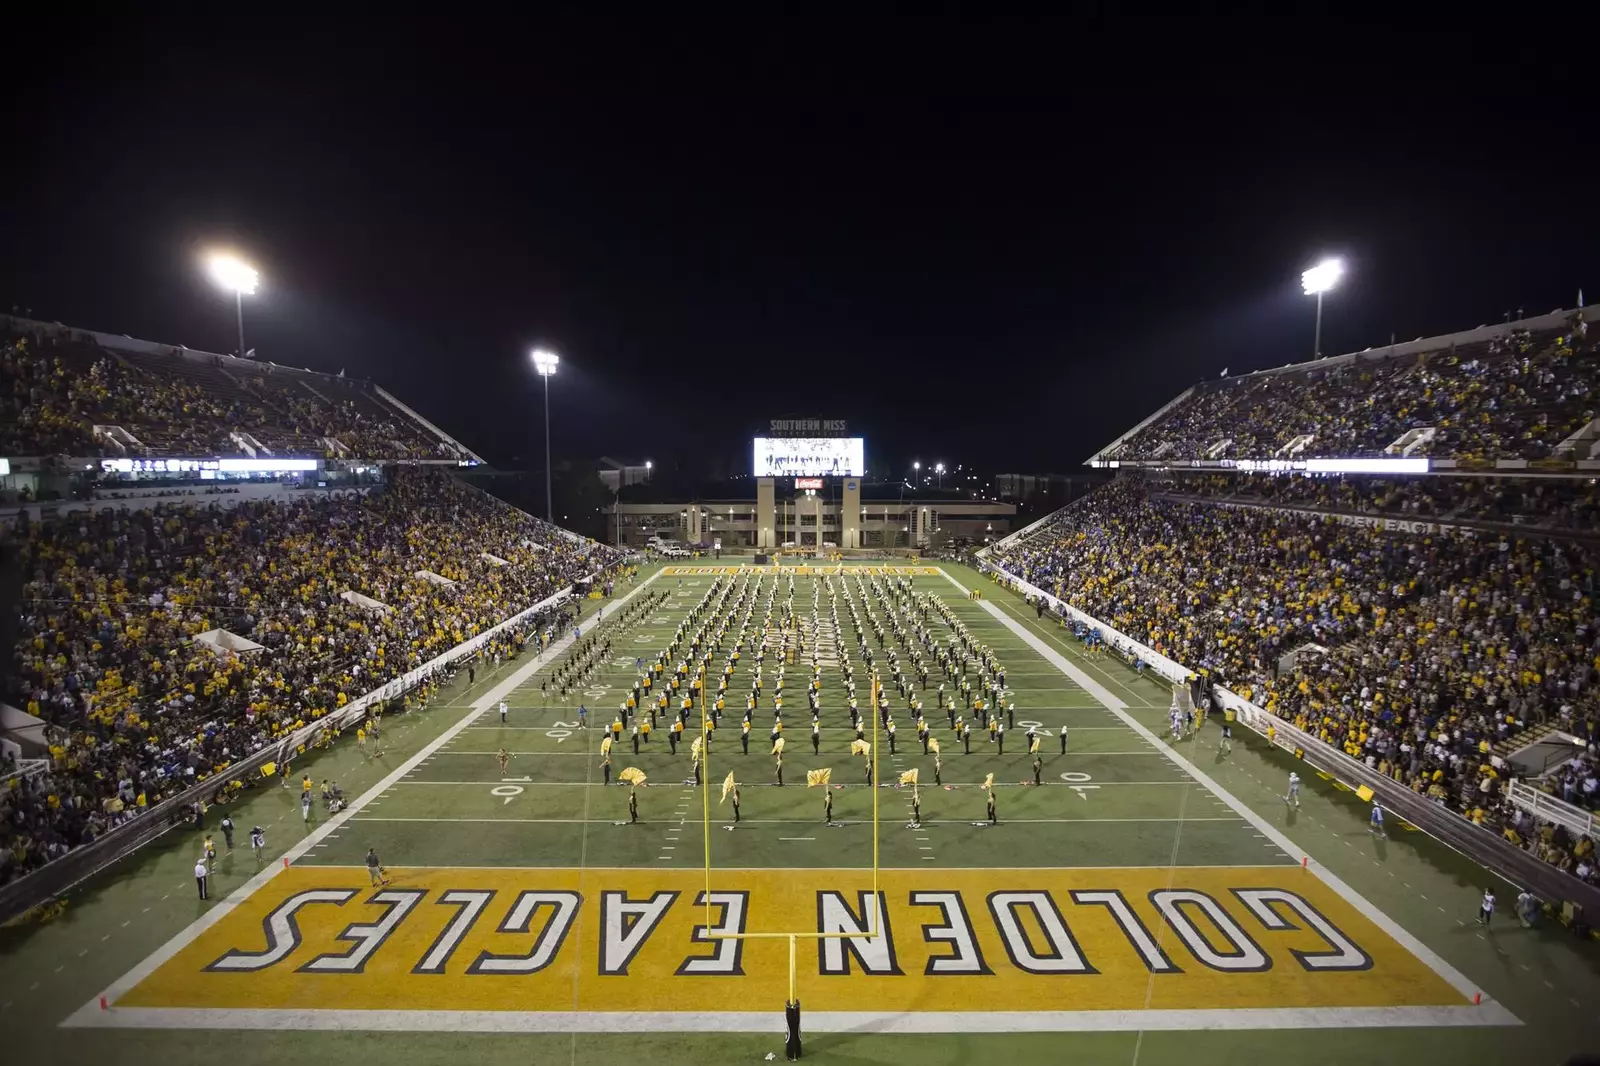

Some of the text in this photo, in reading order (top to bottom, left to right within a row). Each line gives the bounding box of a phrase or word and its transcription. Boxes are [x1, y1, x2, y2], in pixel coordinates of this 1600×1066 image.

[770, 420, 846, 431] SOUTHERN MISS
[584, 683, 612, 696] 30
[545, 721, 579, 738] 20
[491, 776, 532, 796] 10
[1060, 772, 1101, 792] 10
[200, 888, 1375, 976] GOLDEN EAGLES
